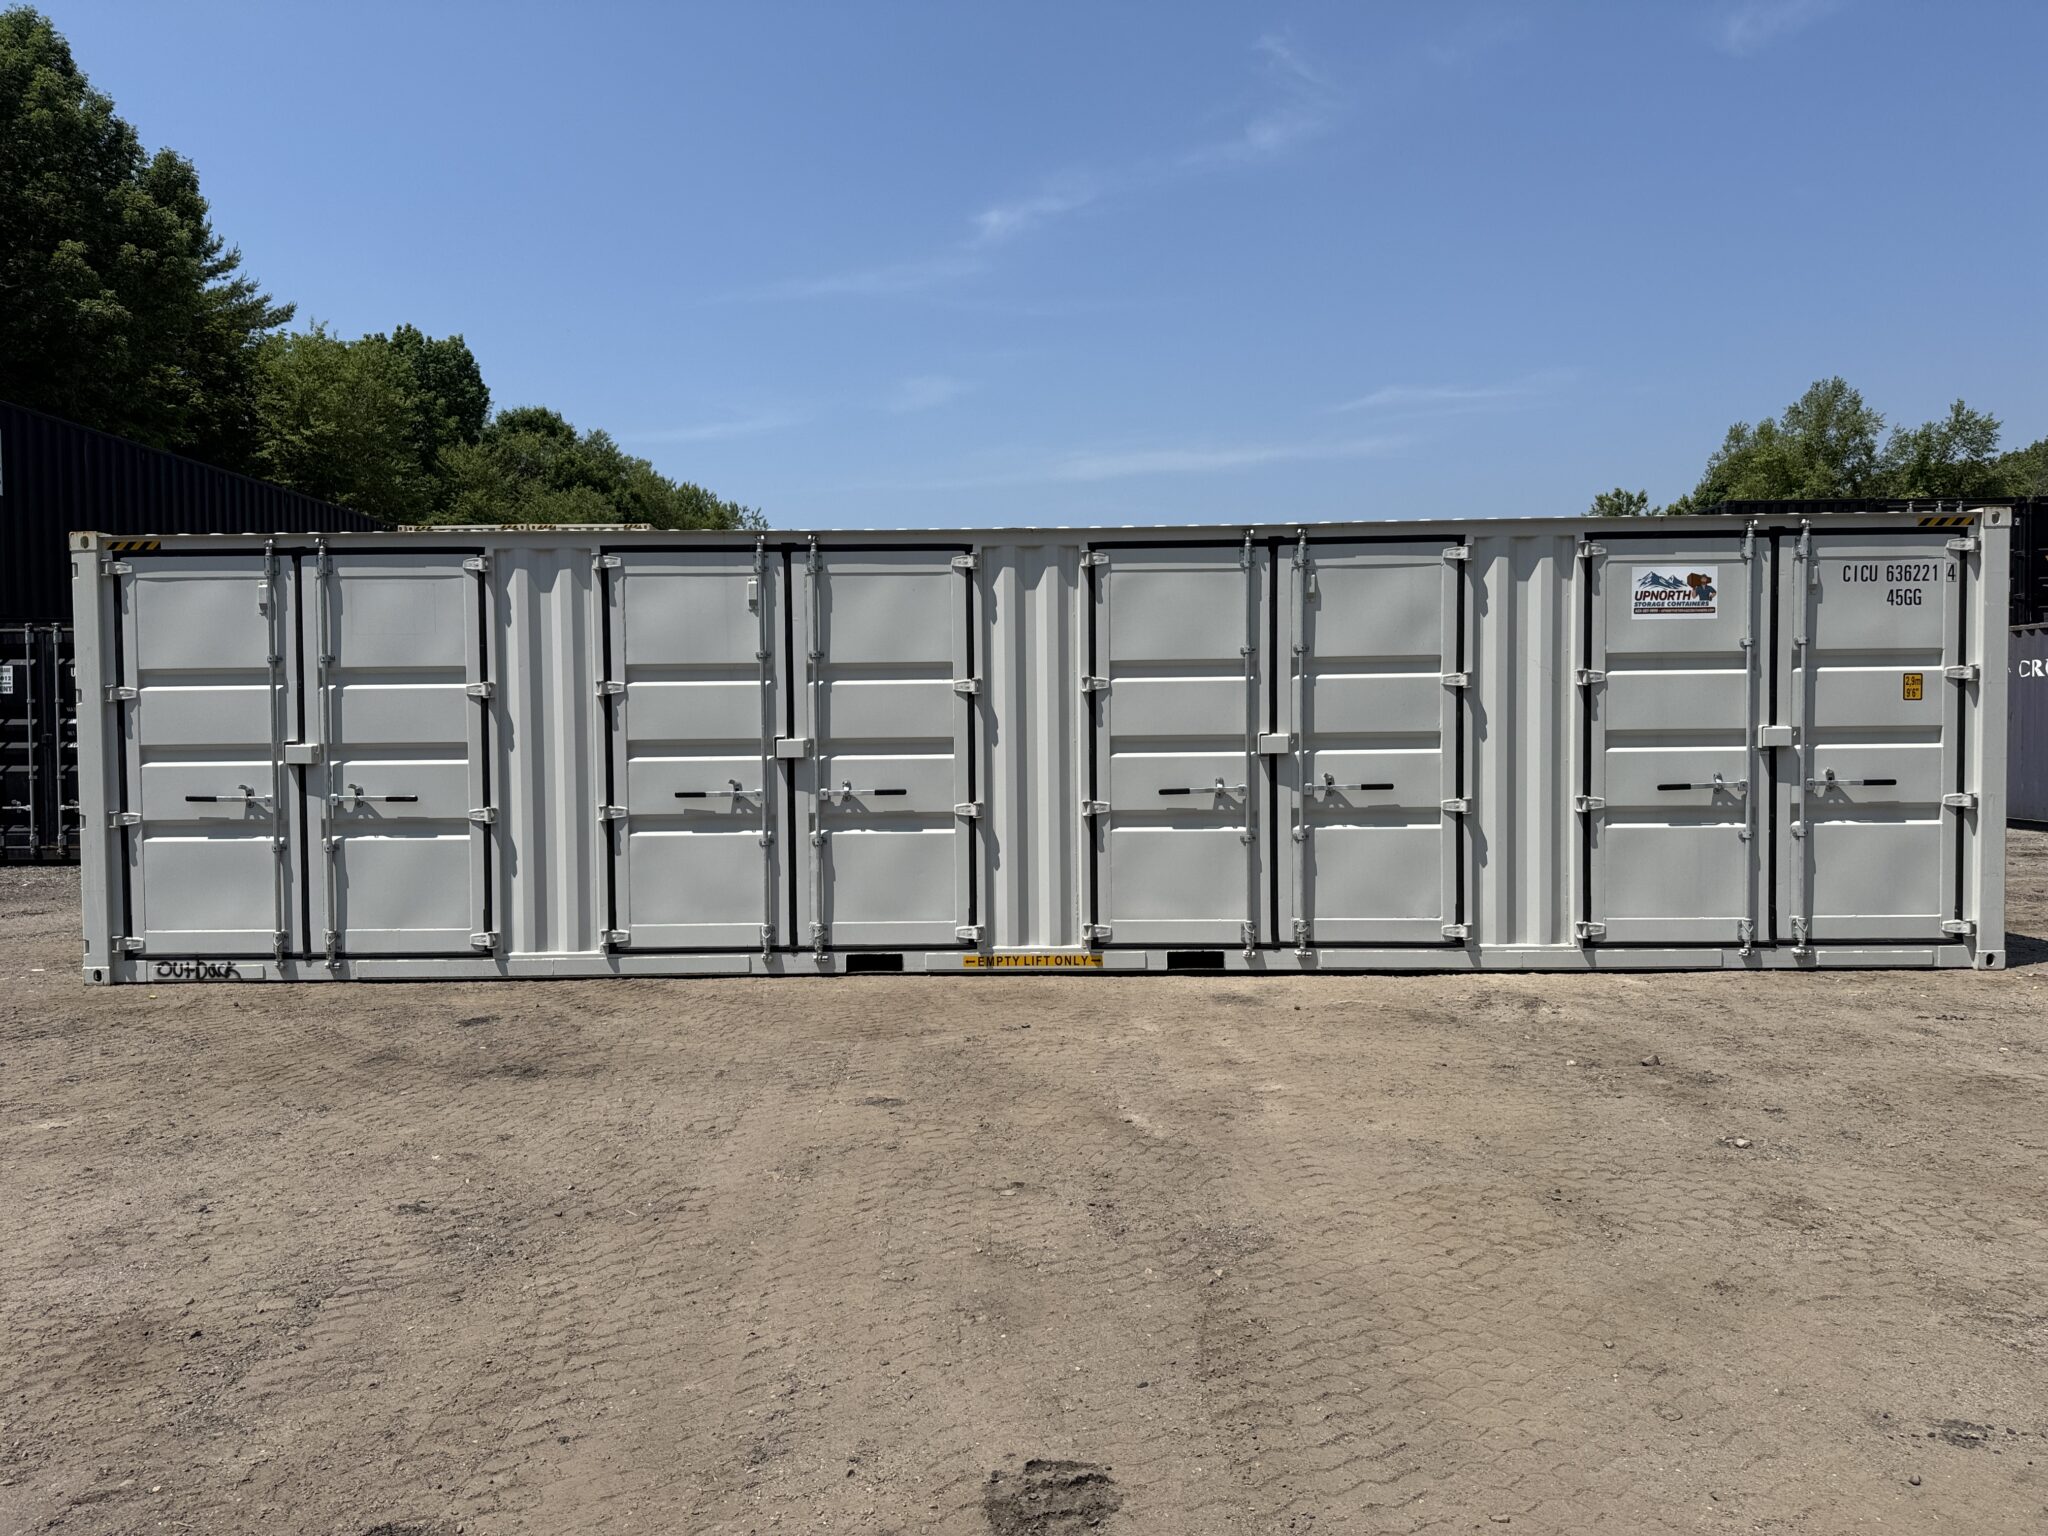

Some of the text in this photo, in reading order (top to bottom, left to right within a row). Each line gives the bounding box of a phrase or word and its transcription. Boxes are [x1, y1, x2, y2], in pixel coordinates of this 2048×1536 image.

[1842, 563, 1956, 583] CICU 636221 4
[1634, 590, 1692, 601] UPNORTH
[1886, 588, 1922, 606] 45GG
[2018, 659, 2048, 677] CR
[978, 955, 1089, 966] EMPTY LIFT ONLY
